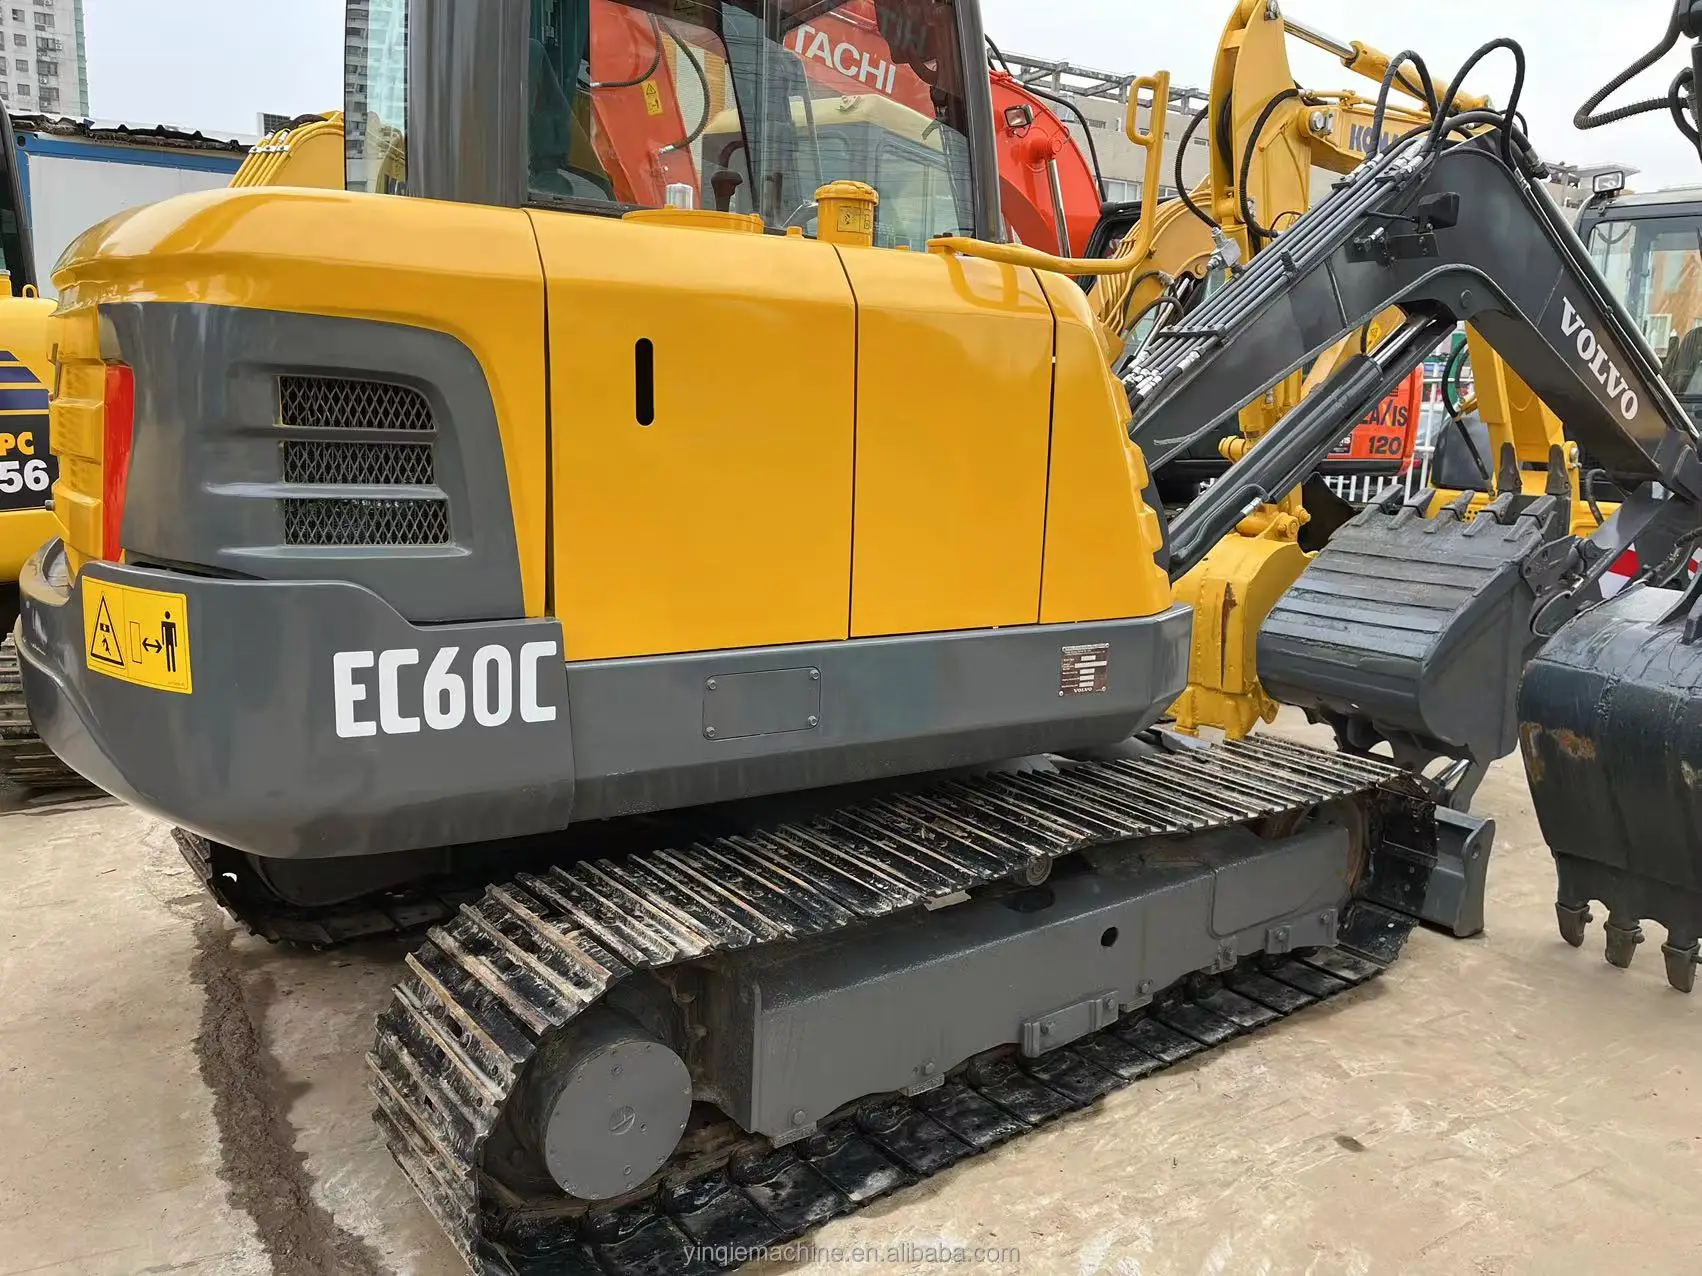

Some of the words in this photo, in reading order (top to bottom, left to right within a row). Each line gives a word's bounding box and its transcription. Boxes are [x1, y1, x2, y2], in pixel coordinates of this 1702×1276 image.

[1561, 296, 1638, 420] VOLVO
[0, 432, 34, 456] PC
[1369, 436, 1402, 455] 120
[0, 459, 49, 493] 56
[333, 641, 557, 738] EC60C
